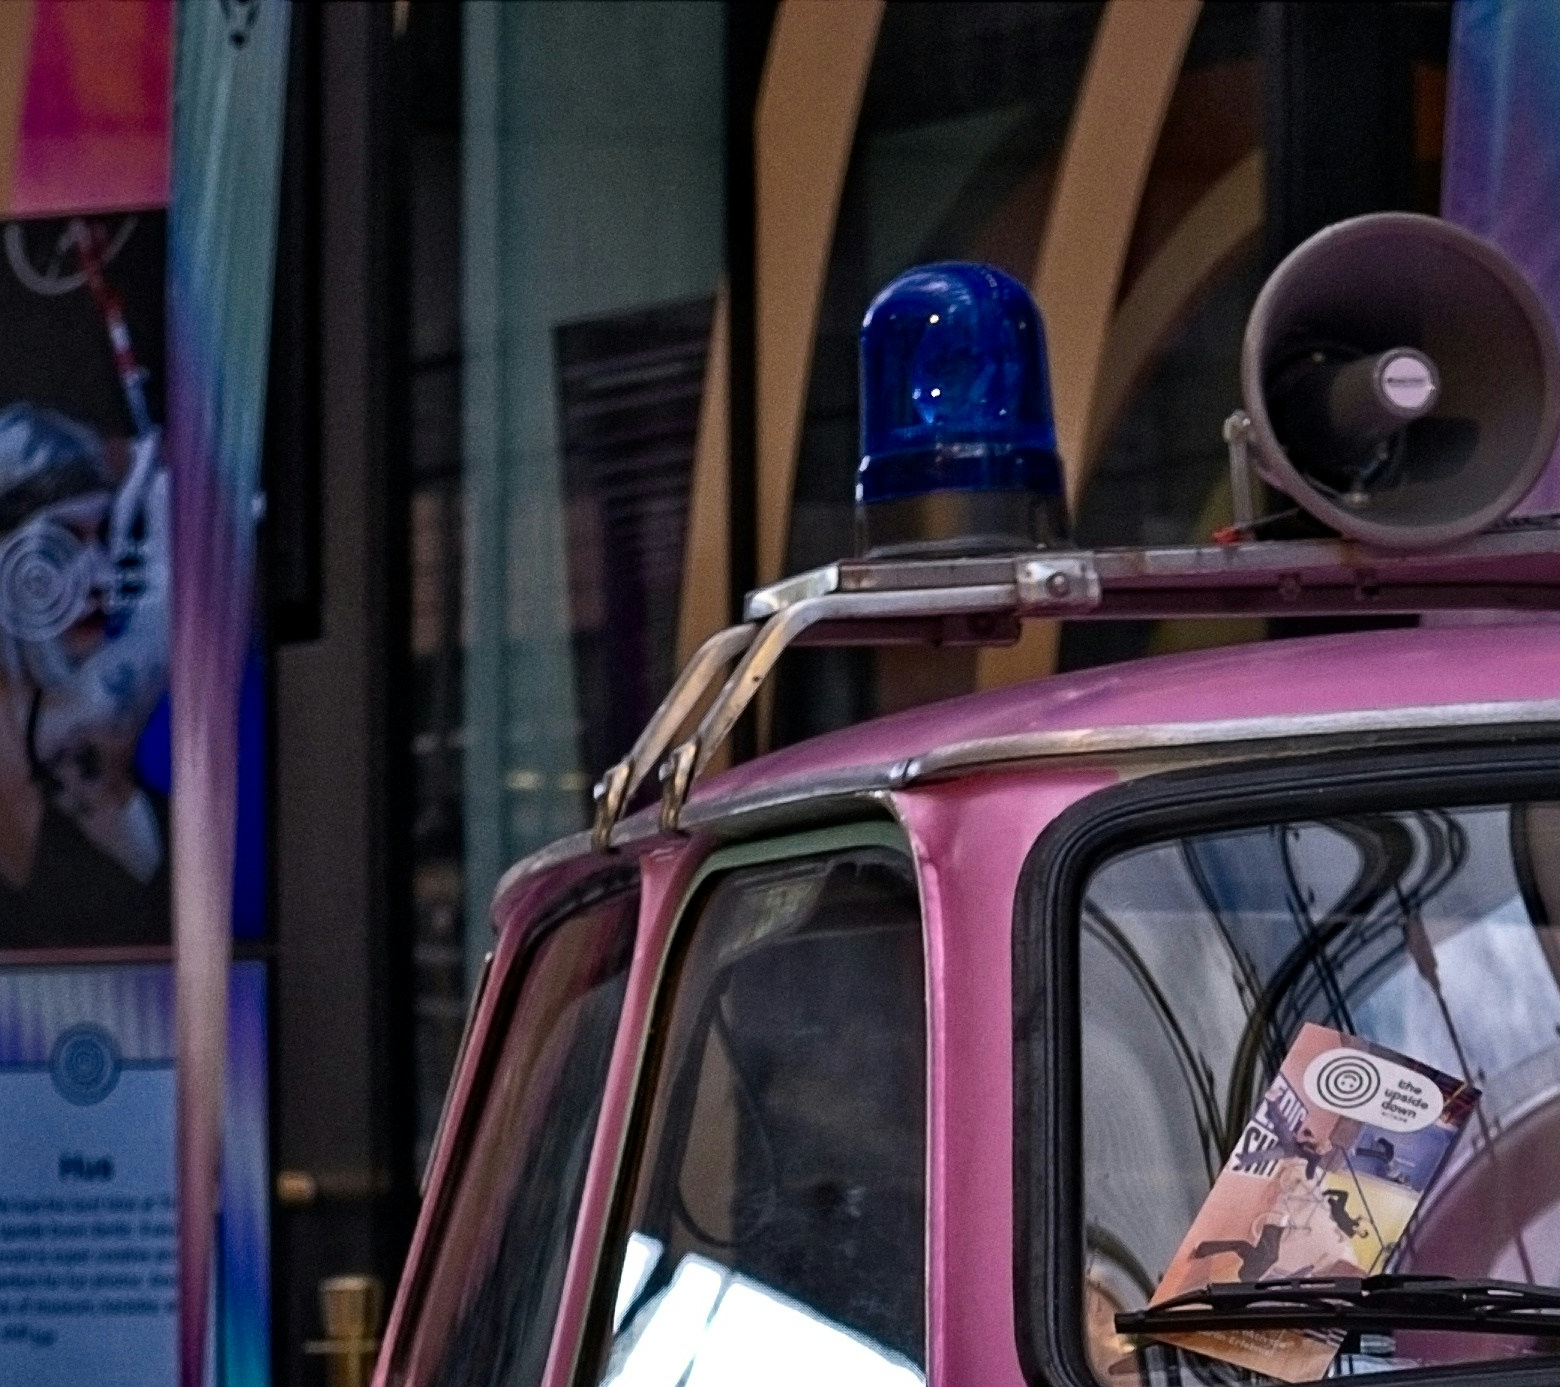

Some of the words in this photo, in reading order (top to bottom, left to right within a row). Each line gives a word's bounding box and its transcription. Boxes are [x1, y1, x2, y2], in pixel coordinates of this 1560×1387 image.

[1398, 1079, 1422, 1095] the
[1384, 1088, 1429, 1110] upside
[1381, 1100, 1417, 1119] down
